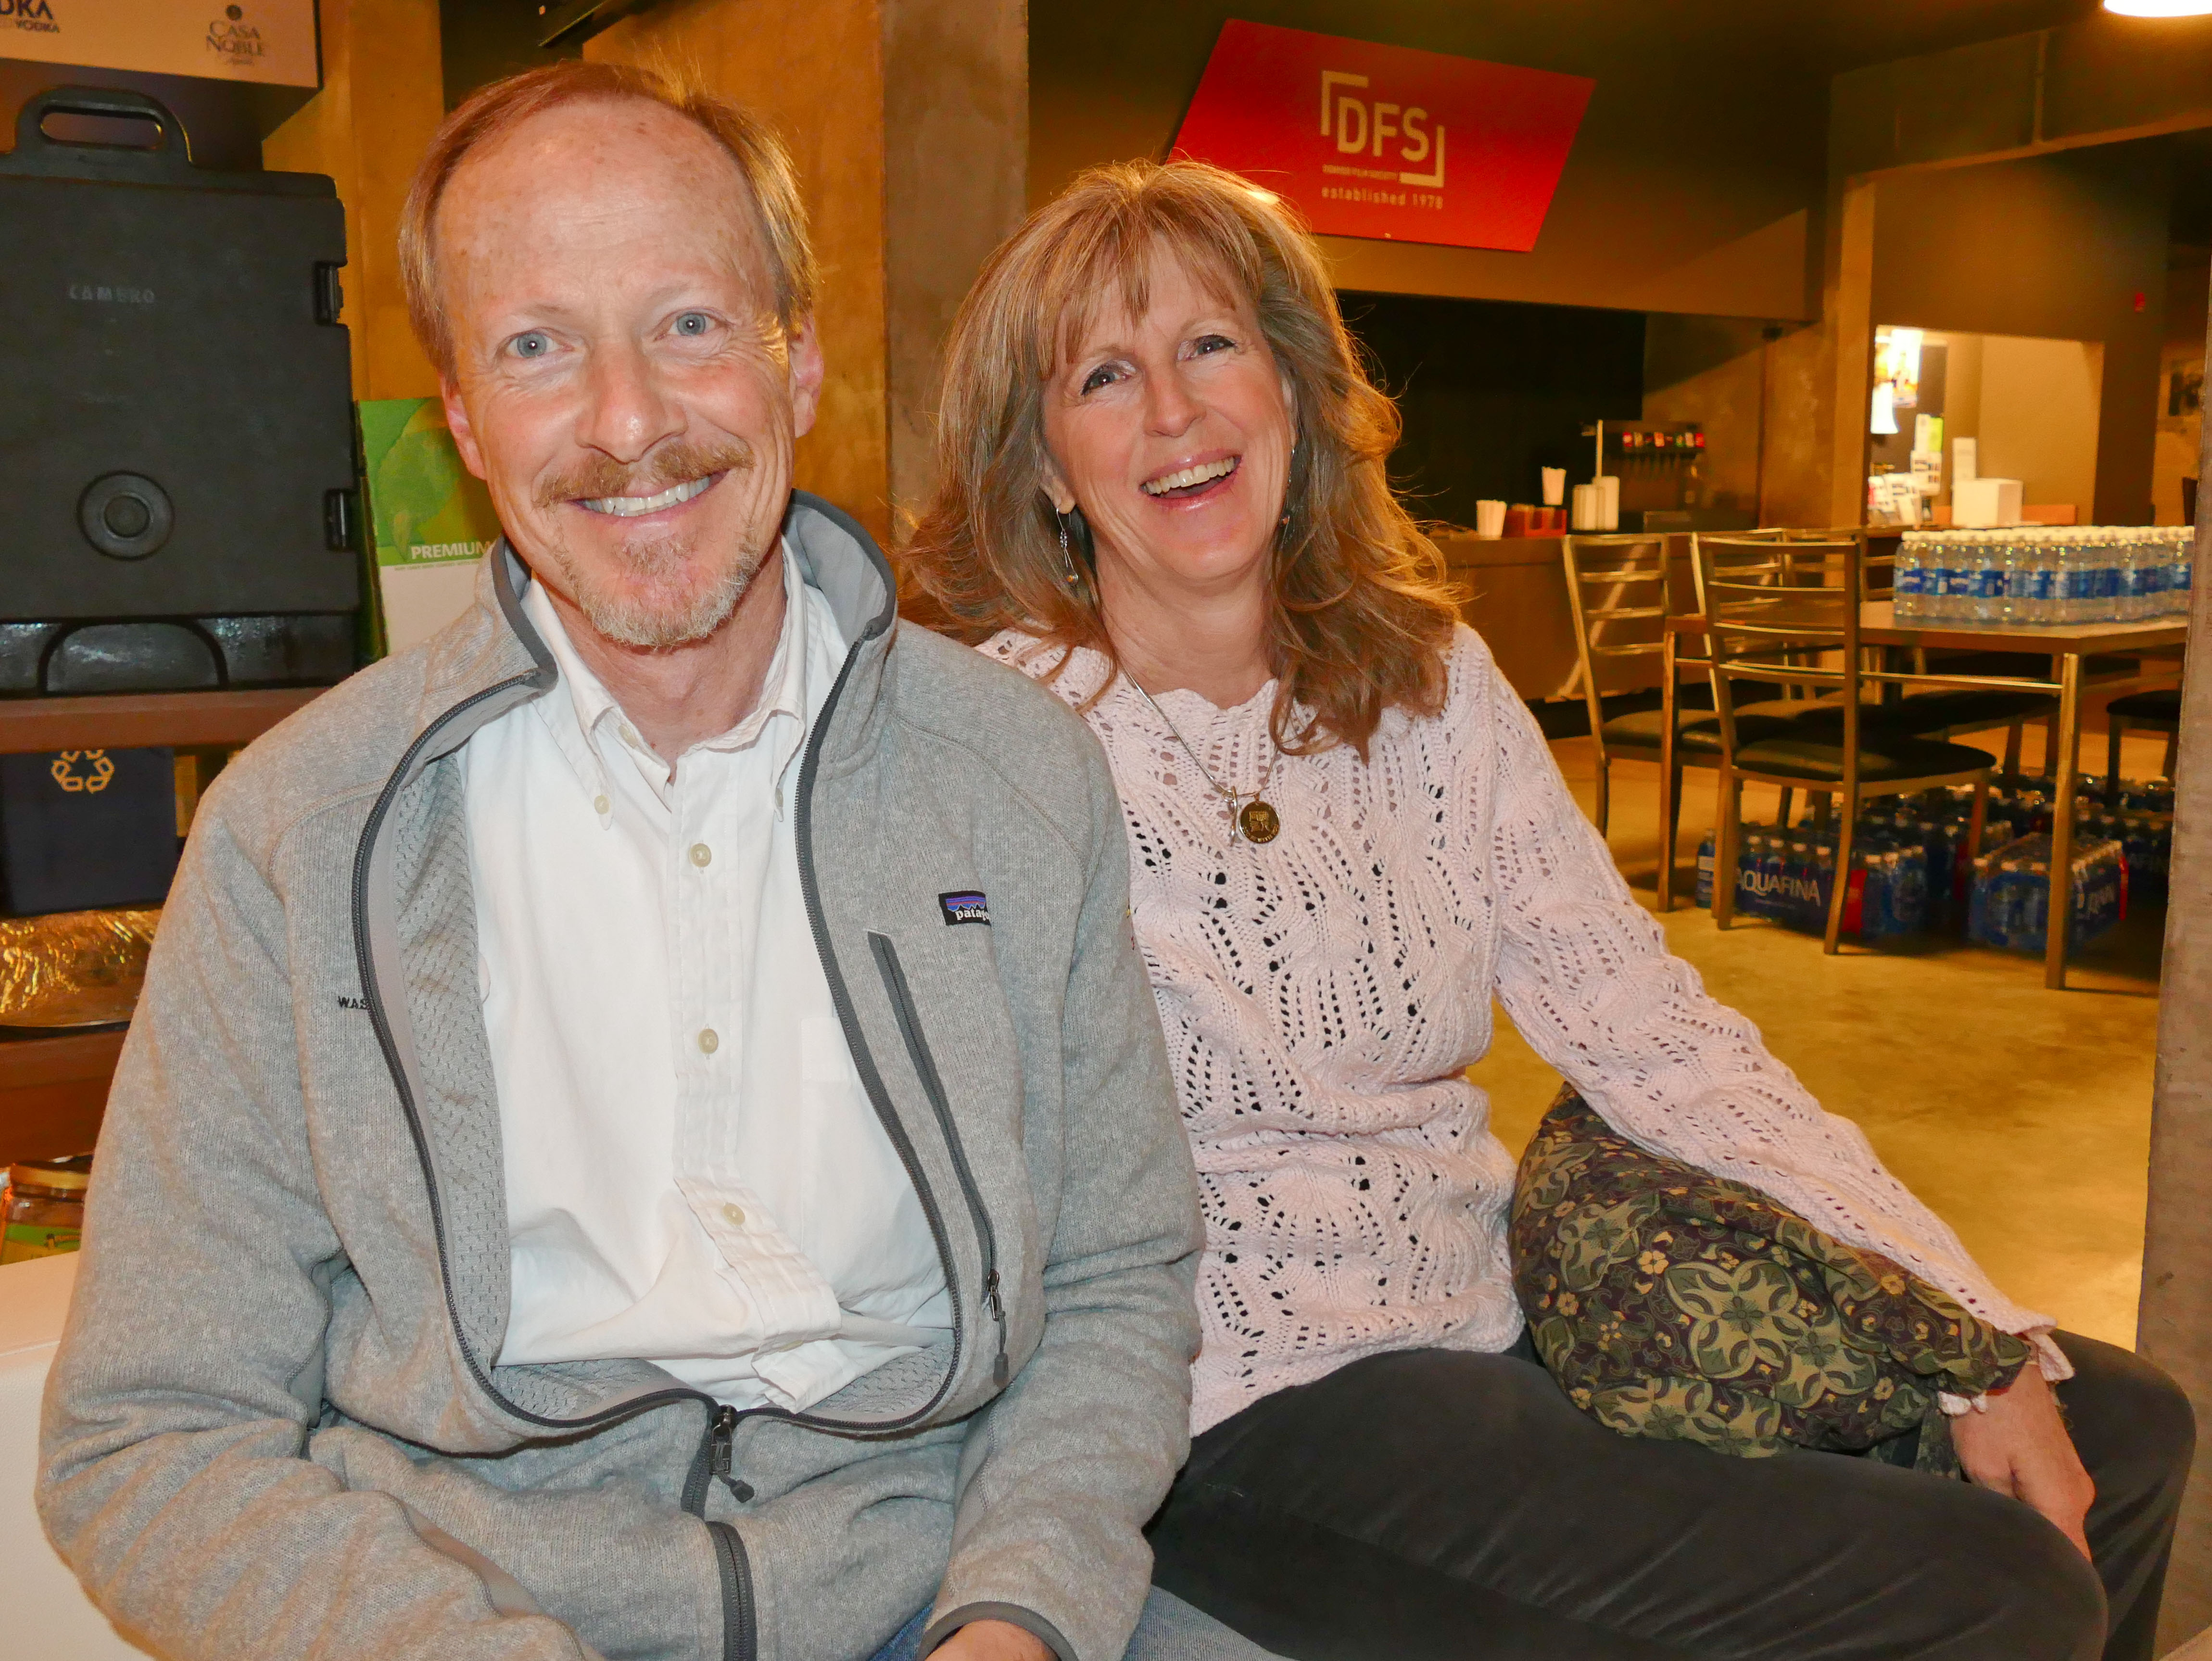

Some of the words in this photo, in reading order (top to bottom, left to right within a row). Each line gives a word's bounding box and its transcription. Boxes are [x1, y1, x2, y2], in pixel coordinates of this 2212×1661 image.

[210, 20, 261, 39] CASA
[1337, 96, 1429, 162] DFS
[1321, 186, 1406, 207] established
[411, 541, 492, 560] PREMIUM
